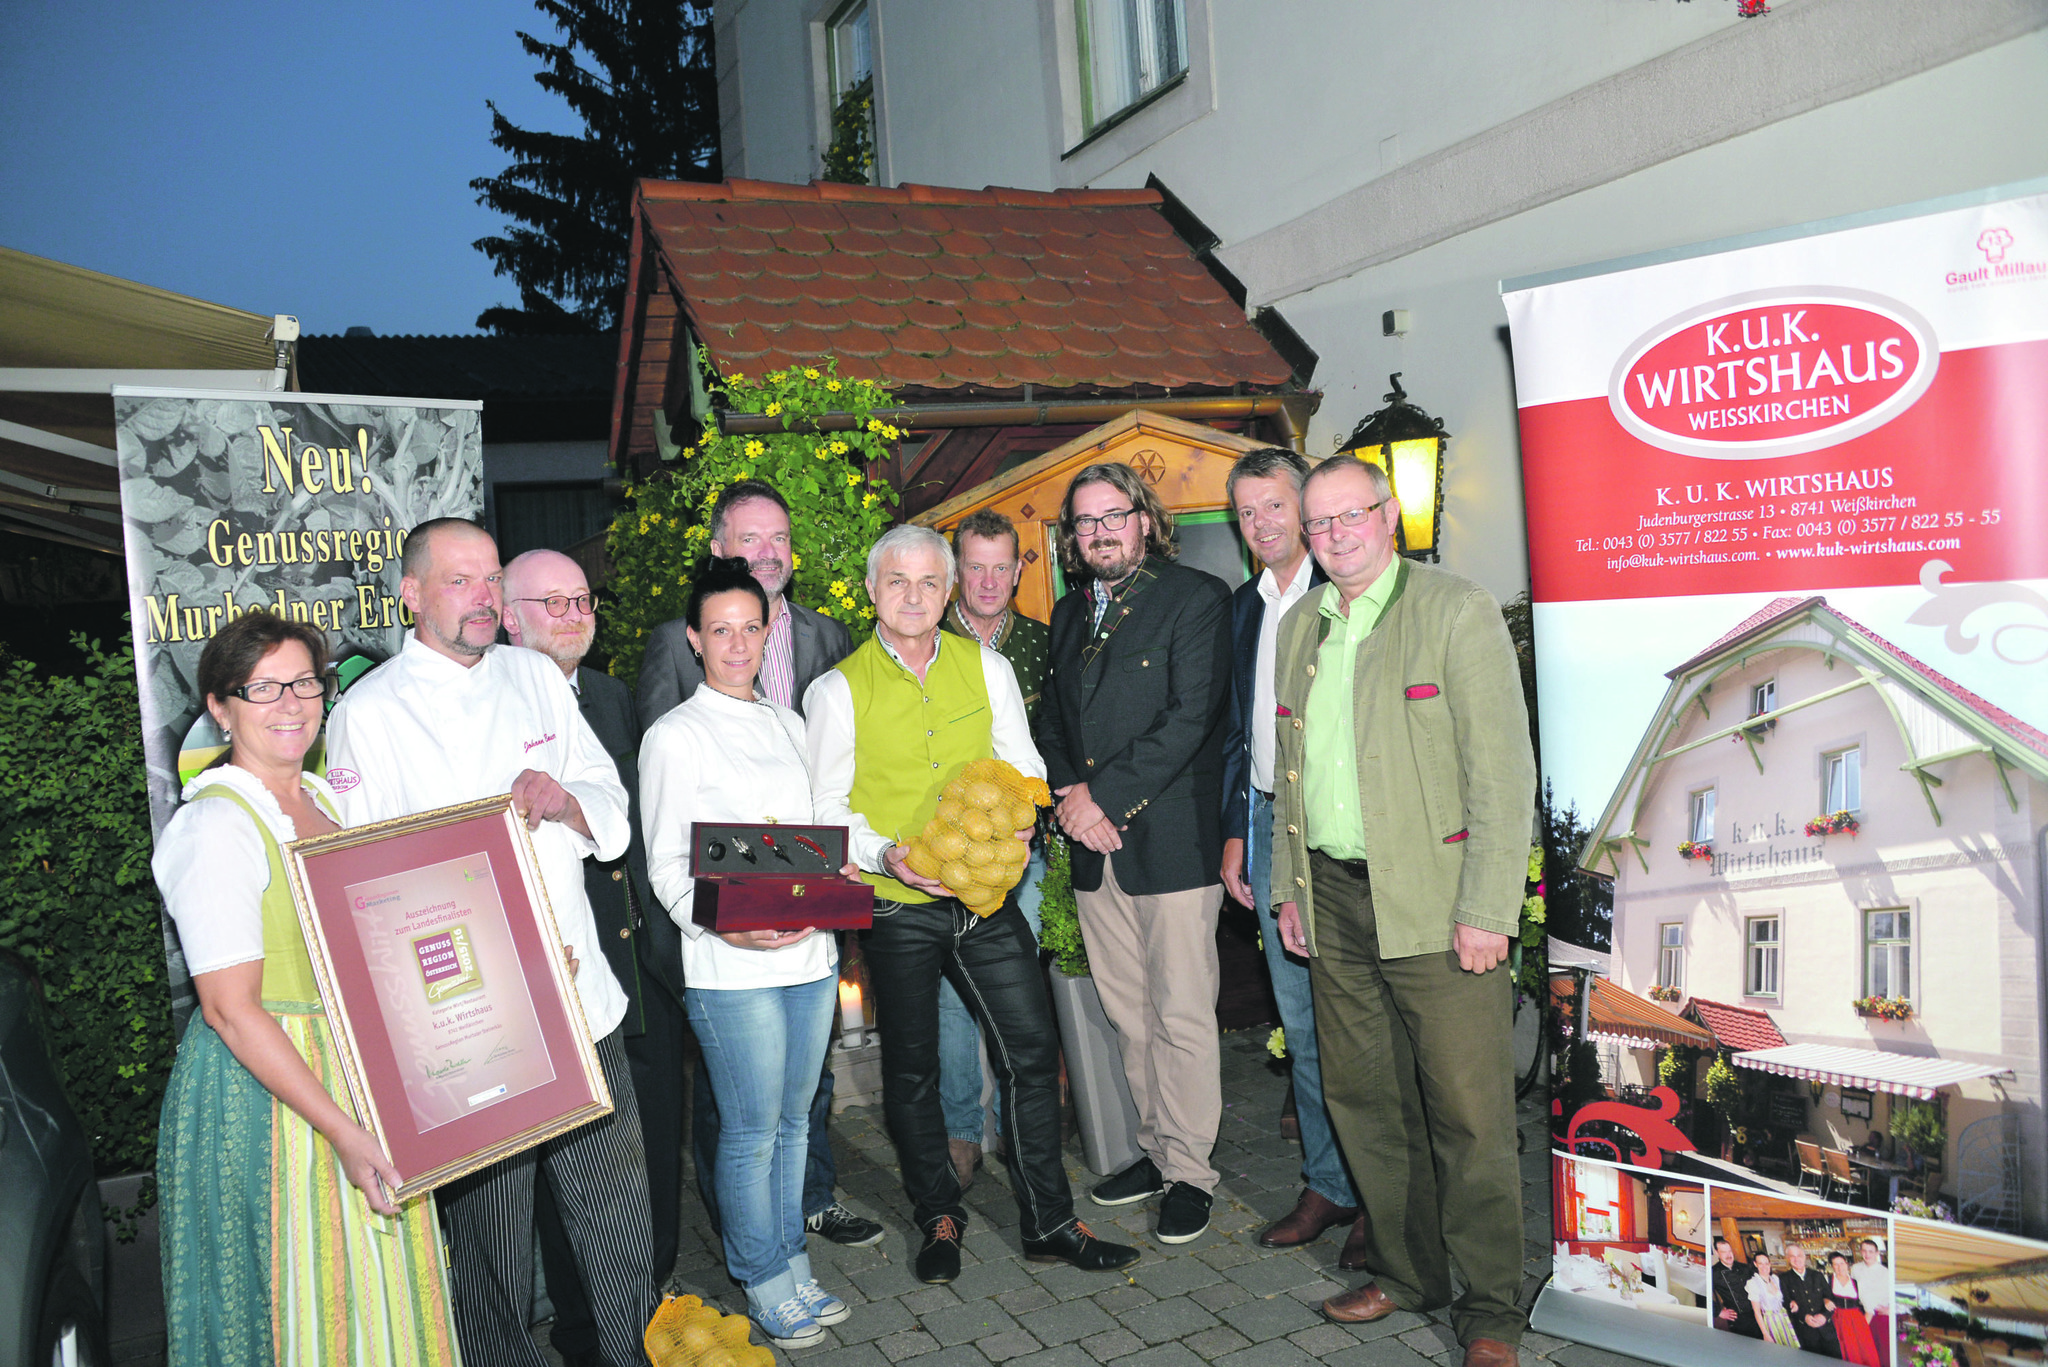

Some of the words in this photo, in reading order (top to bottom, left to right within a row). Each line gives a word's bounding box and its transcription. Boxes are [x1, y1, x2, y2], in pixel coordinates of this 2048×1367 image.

[1946, 267, 1989, 286] Gault
[1994, 262, 2047, 278] Millau
[1706, 310, 1820, 356] K.U.K.
[1636, 338, 1904, 409] WIRTSHAUS
[1688, 393, 1850, 431] WEISSKIRCHEN
[257, 426, 372, 495] Neu!
[1656, 487, 1680, 506] K.
[1685, 485, 1709, 502] U.
[1716, 482, 1740, 501] K.
[1745, 467, 1894, 499] WIRTSHAUS
[1576, 538, 1599, 552] Tel.:
[1603, 536, 1633, 550] 0043
[1638, 533, 1655, 549] (0)
[1659, 531, 1690, 546] 3577
[1703, 529, 1728, 543] 822
[1731, 527, 1748, 541] 55
[1763, 525, 1791, 539] Fax:
[1796, 521, 1832, 537] 0043
[1837, 518, 1856, 535] (0)
[1861, 517, 1896, 532] 3577
[1911, 513, 1939, 529] 822
[1944, 511, 1963, 527] 55
[1980, 509, 2001, 525] 55
[1637, 508, 1754, 531] Judenburgerstrasse
[1759, 504, 1775, 519] 13
[1790, 501, 1824, 516] 8741
[1830, 494, 1917, 516] Weißkirchen
[207, 516, 408, 573] Genussregio
[1607, 550, 1760, 572] info@kuk-wirtshaus.com.
[1776, 537, 1961, 559] www.kuk-wirtshaus.com
[356, 585, 415, 629] Erd
[1732, 812, 1796, 844] k.u.k.
[1710, 844, 1826, 877] Wirtshaus
[395, 926, 411, 935] zum
[412, 908, 472, 930] Landesfinalisten
[405, 901, 457, 920] Auszeichnung
[418, 939, 451, 954] GENUSS
[422, 950, 455, 967] REGION
[454, 928, 473, 971] 2015/16
[425, 962, 458, 977] ÖSTERREICH
[432, 1017, 455, 1030] k.u.k.
[455, 1004, 493, 1022] Wirtshaus
